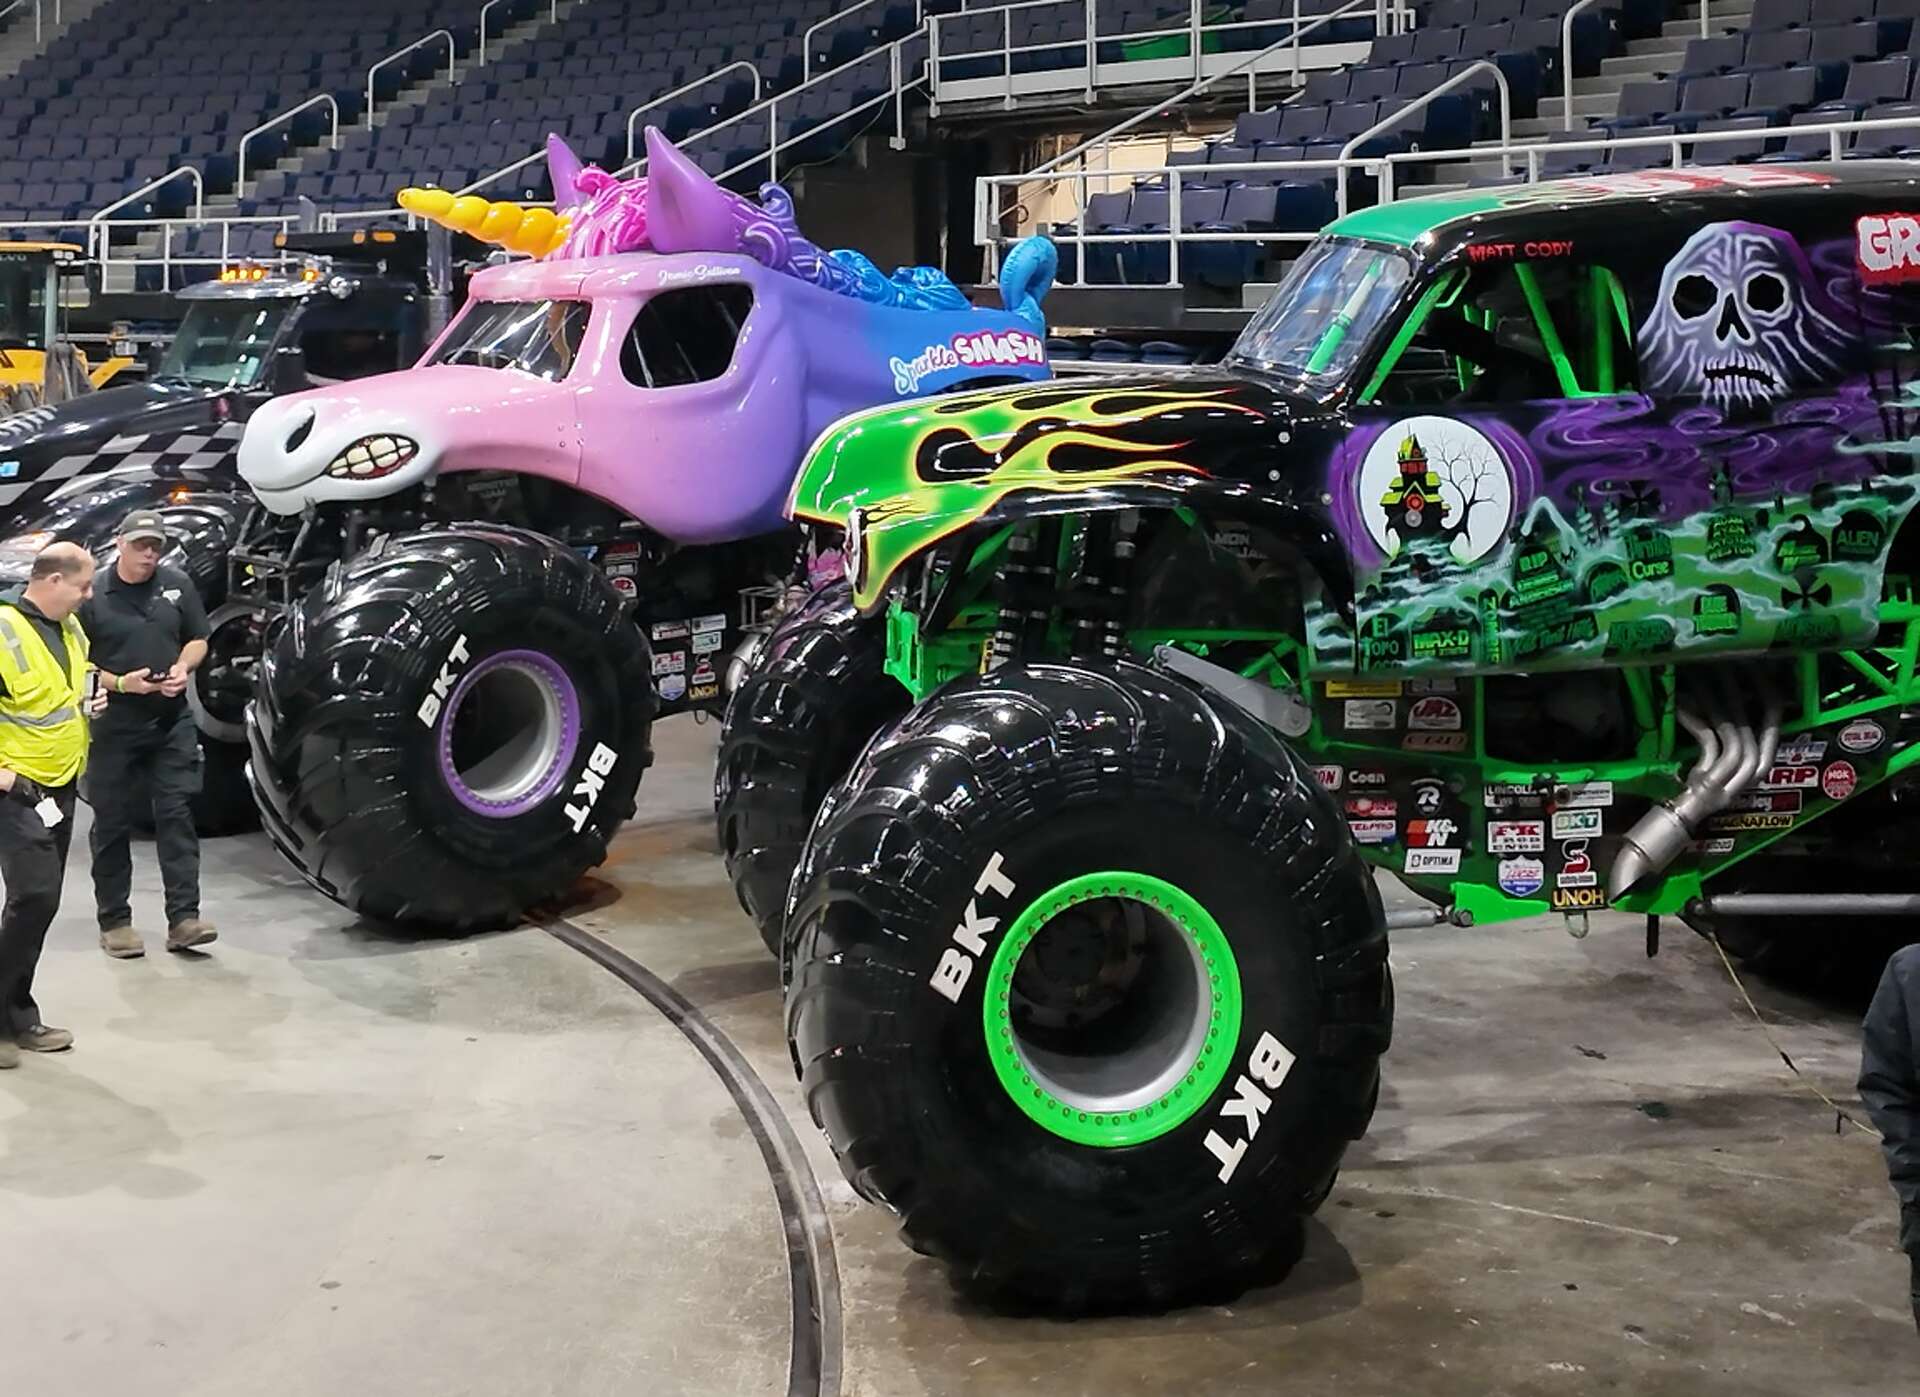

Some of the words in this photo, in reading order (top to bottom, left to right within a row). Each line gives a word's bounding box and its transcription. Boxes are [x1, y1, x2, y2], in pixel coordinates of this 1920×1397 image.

[1609, 19, 1617, 31] K
[1546, 58, 1553, 69] J
[1467, 244, 1516, 262] MATT
[1524, 241, 1573, 257] CODY
[890, 344, 958, 395] Sparkle
[953, 330, 1045, 367] SMASH
[1519, 552, 1548, 572] RIP
[1631, 560, 1670, 580] Curse
[417, 634, 470, 728] BKT
[564, 742, 618, 833] BKT
[1349, 771, 1386, 784] Coan
[1556, 812, 1600, 831] BKT
[1422, 855, 1453, 866] OPTIMA
[1553, 888, 1604, 906] UNOH
[929, 851, 1016, 1004] BKT
[1203, 1031, 1296, 1184] BKT
